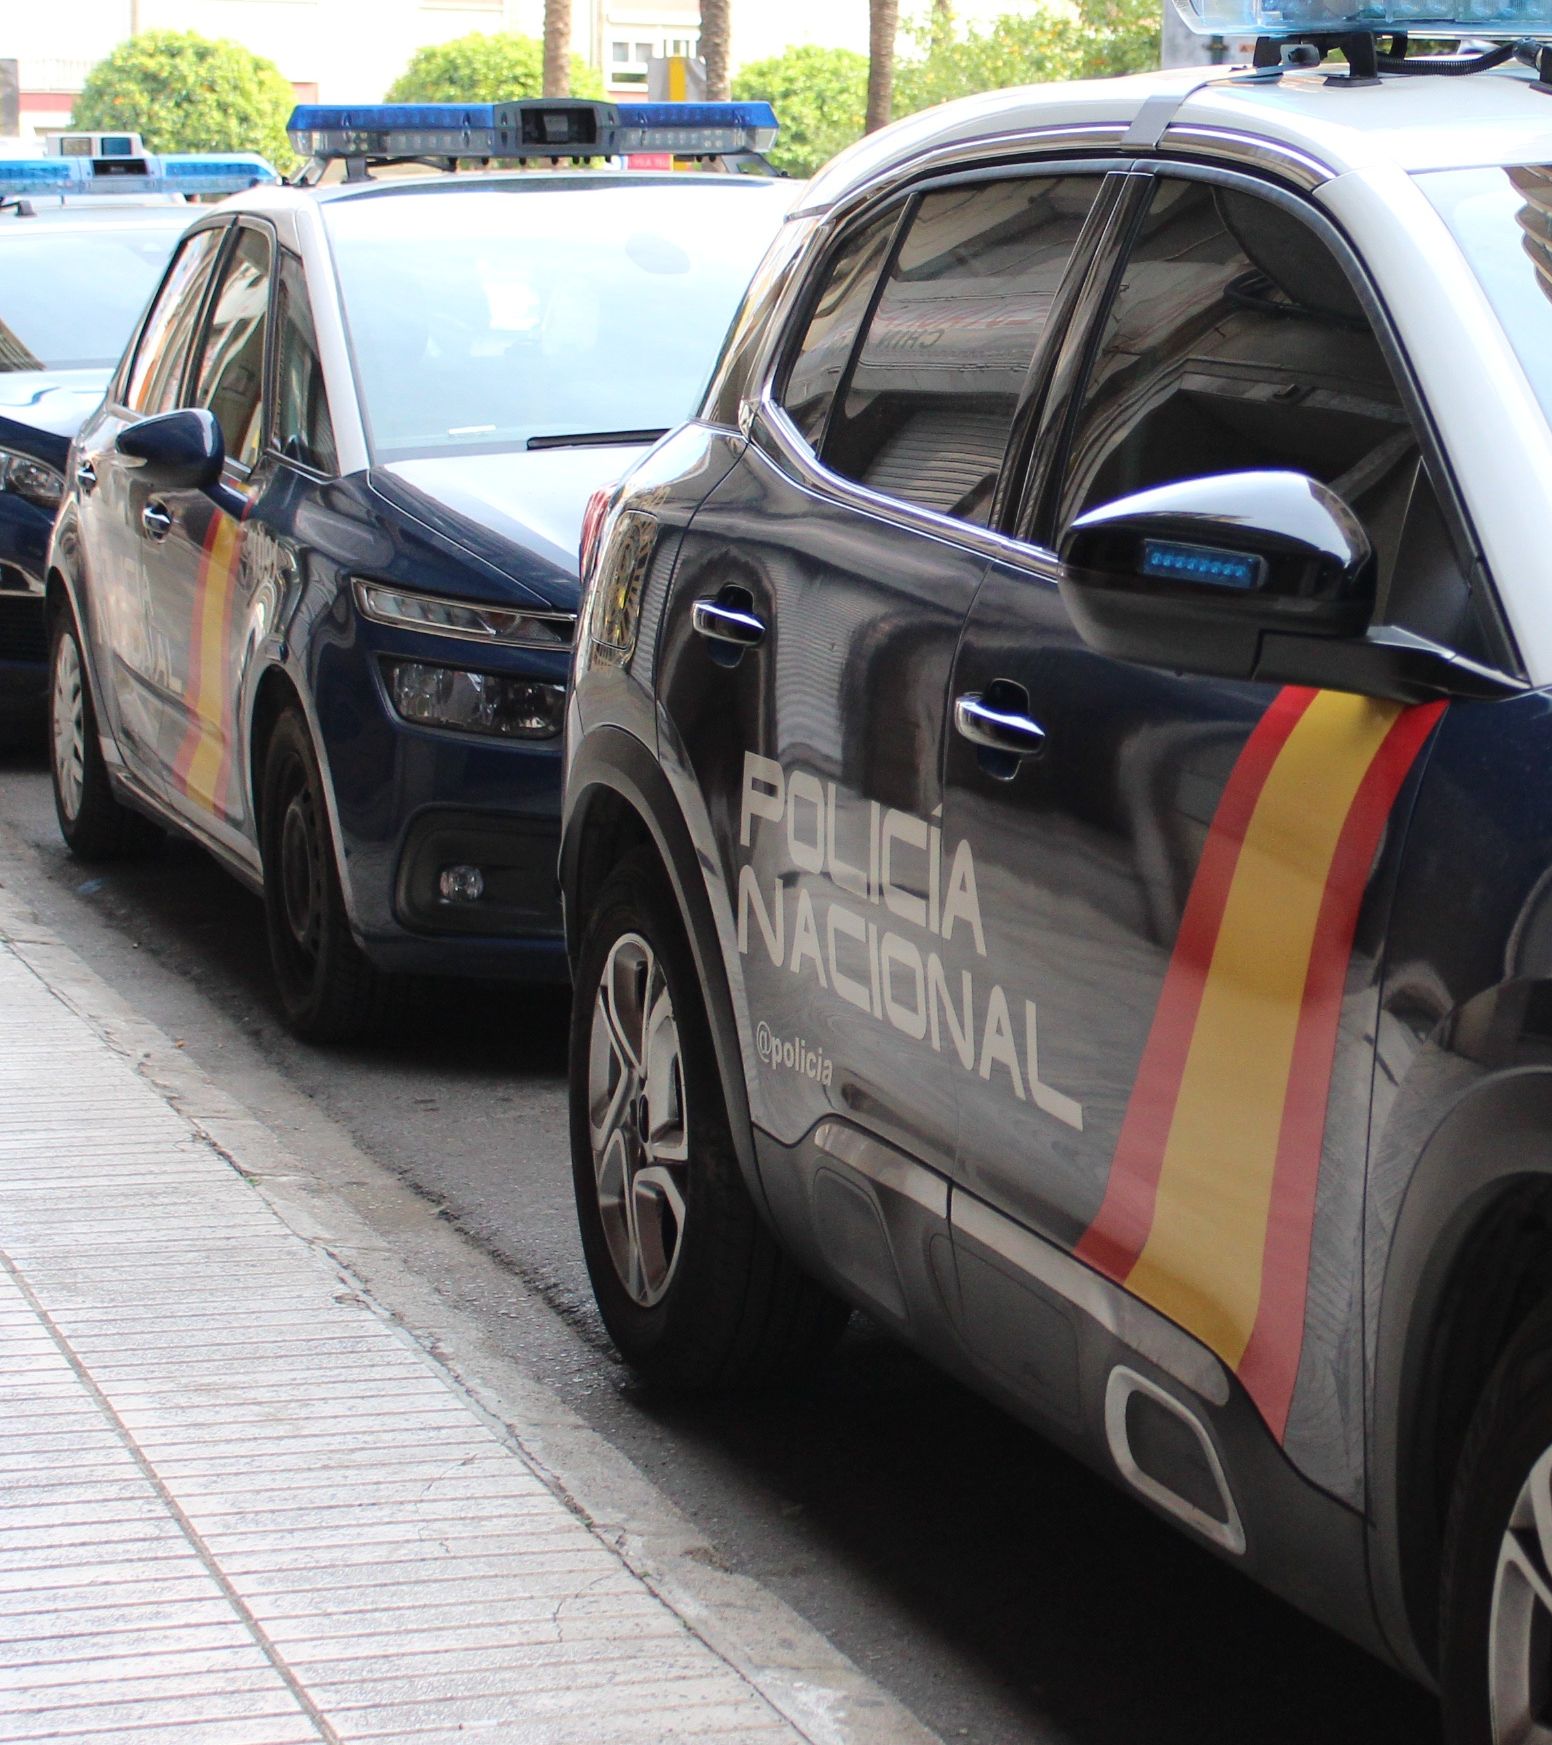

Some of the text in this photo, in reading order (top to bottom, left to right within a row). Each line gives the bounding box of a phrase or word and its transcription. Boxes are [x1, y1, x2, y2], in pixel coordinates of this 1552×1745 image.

[739, 750, 988, 958] POLICÍA
[737, 864, 1084, 1132] NACIONAL
[756, 1019, 834, 1087] @policia
